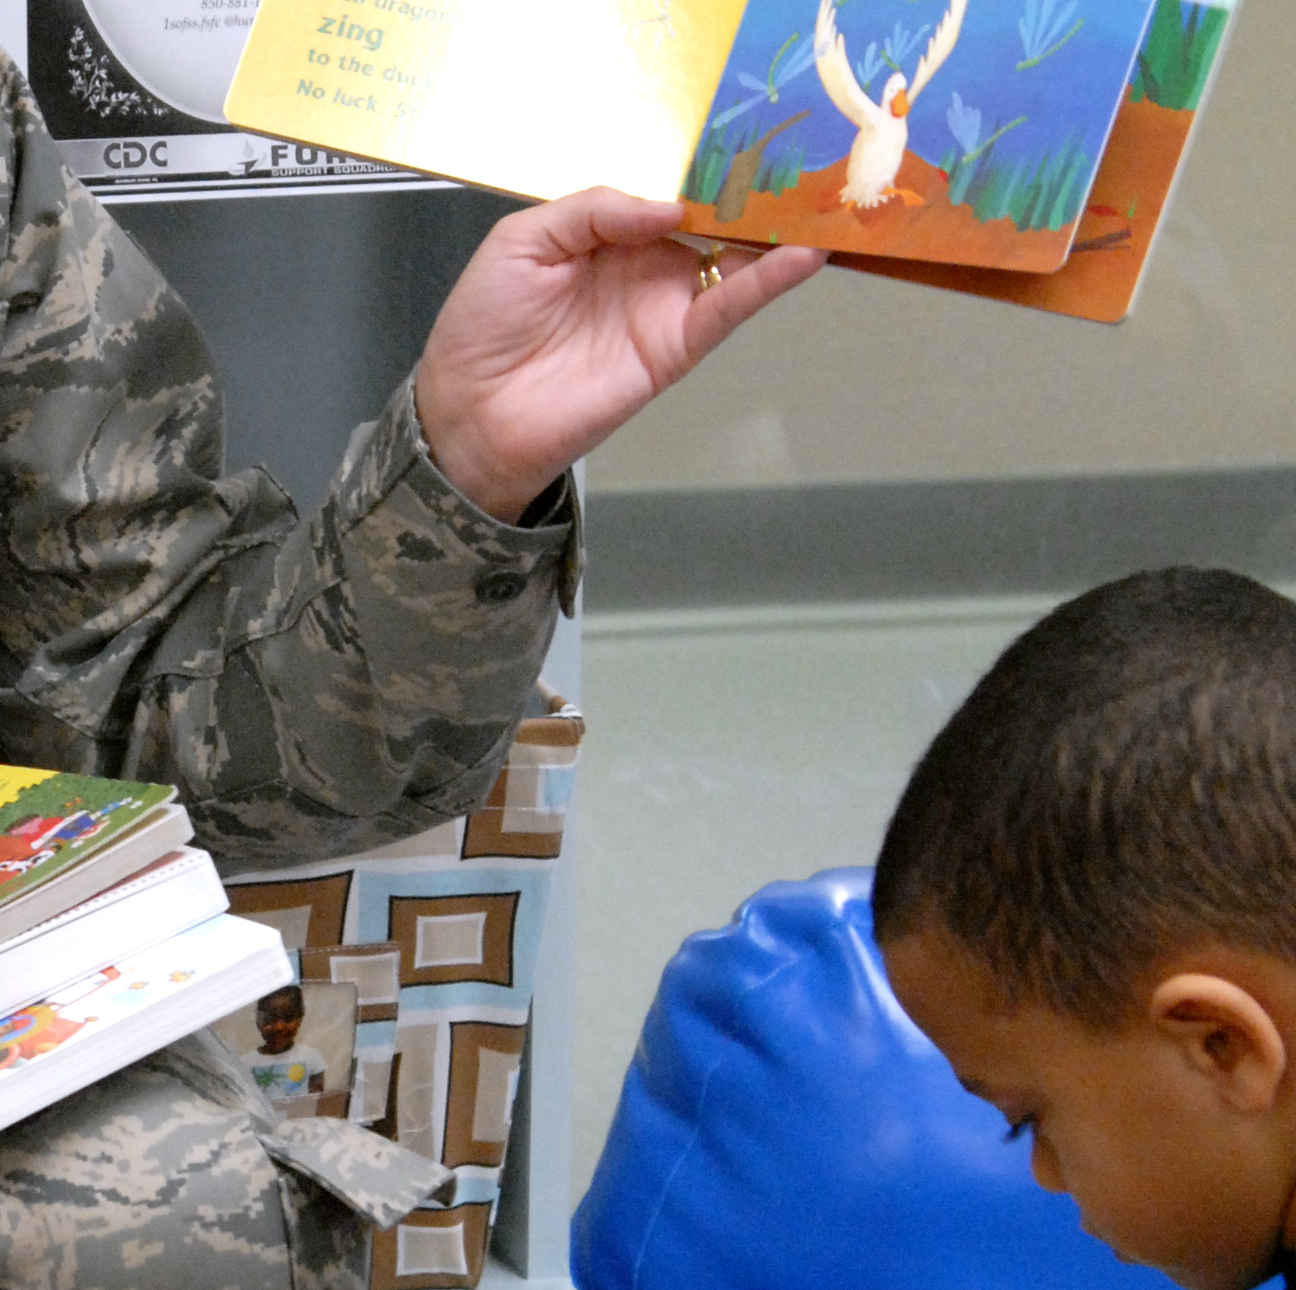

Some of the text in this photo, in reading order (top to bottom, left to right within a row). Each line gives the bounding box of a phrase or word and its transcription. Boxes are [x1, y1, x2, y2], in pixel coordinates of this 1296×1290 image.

[317, 13, 385, 52] zing
[307, 47, 434, 91] to the duck
[296, 78, 326, 100] No
[104, 140, 169, 170] CDC
[271, 166, 328, 178] SUPPORT
